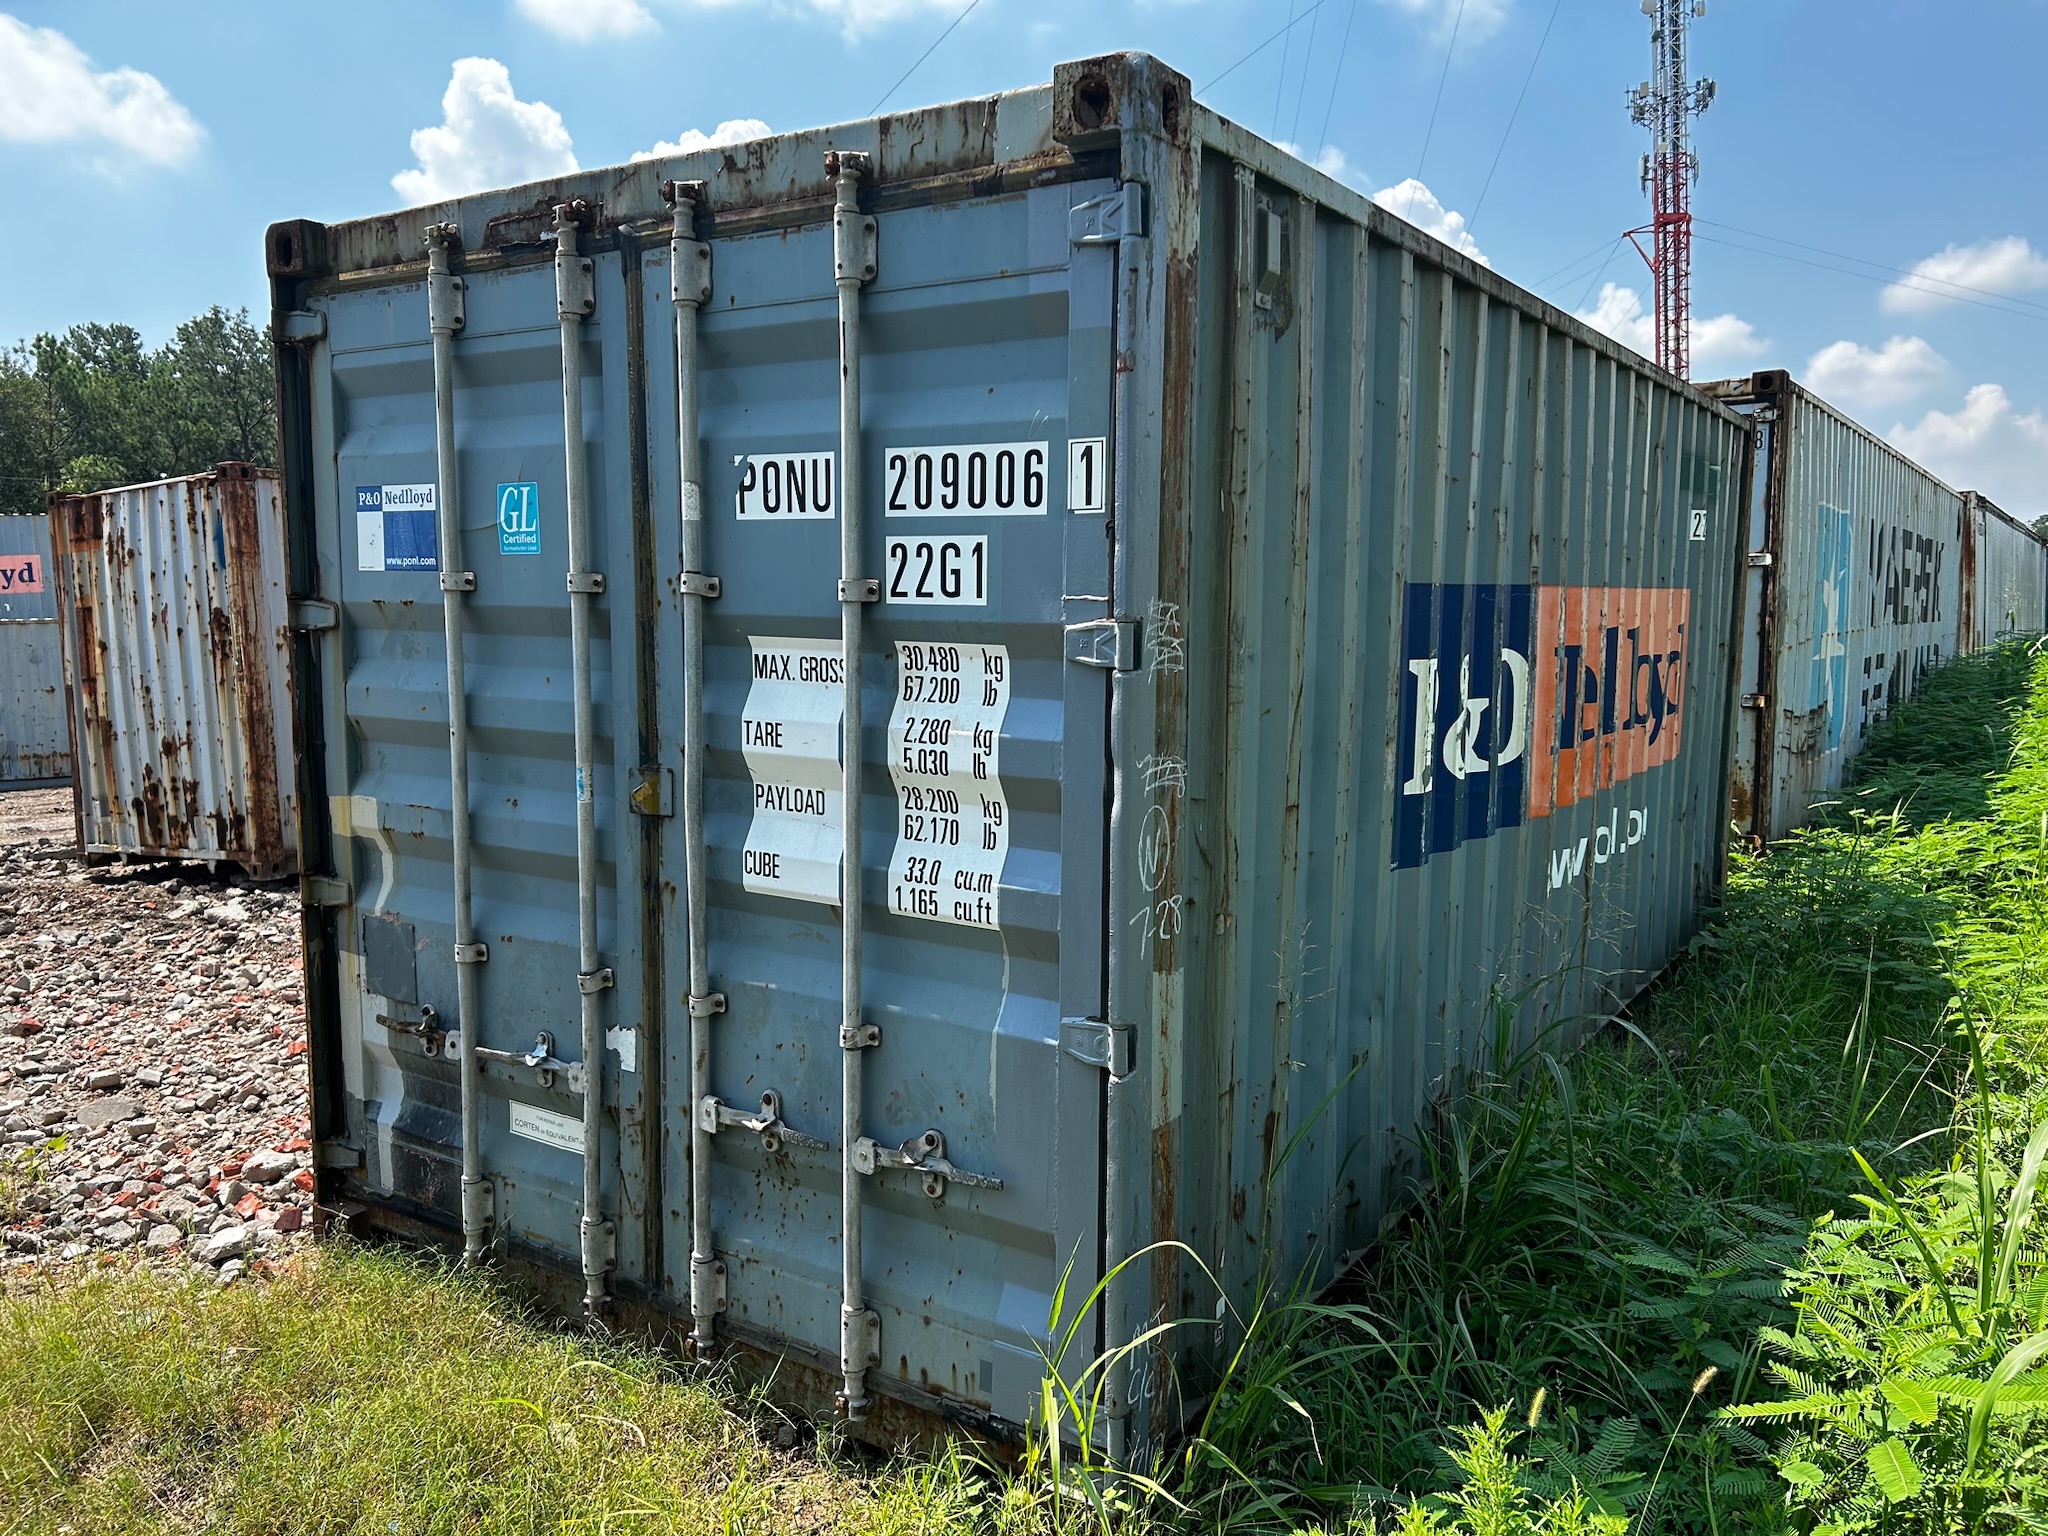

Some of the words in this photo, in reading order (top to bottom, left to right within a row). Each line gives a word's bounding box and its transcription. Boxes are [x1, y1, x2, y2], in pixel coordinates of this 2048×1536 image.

[738, 458, 832, 514] PONU
[888, 448, 1045, 511] 209006
[1080, 444, 1094, 507] 1
[358, 491, 381, 506] P&O
[384, 487, 433, 508] Nedlloyd
[500, 486, 537, 533] GL
[503, 533, 537, 544] Certified
[386, 556, 437, 568] www.ponl.com
[890, 541, 983, 600] 22G1
[754, 653, 796, 681] MAX.
[800, 655, 844, 685] GROSS
[981, 648, 1004, 682] kg
[982, 679, 998, 707] lb
[743, 720, 783, 749] TARE
[973, 721, 993, 756] kg
[973, 752, 987, 780] lb
[755, 783, 825, 816] PAYLOAD
[980, 793, 1002, 827] kg
[982, 822, 997, 850] lb
[744, 849, 780, 880] CUBE
[904, 856, 942, 887] 33.0
[954, 869, 993, 894] cu.m
[954, 896, 993, 926] cu.ft
[514, 1118, 540, 1133] CORTEN
[546, 1129, 579, 1144] EQUIVALENT
